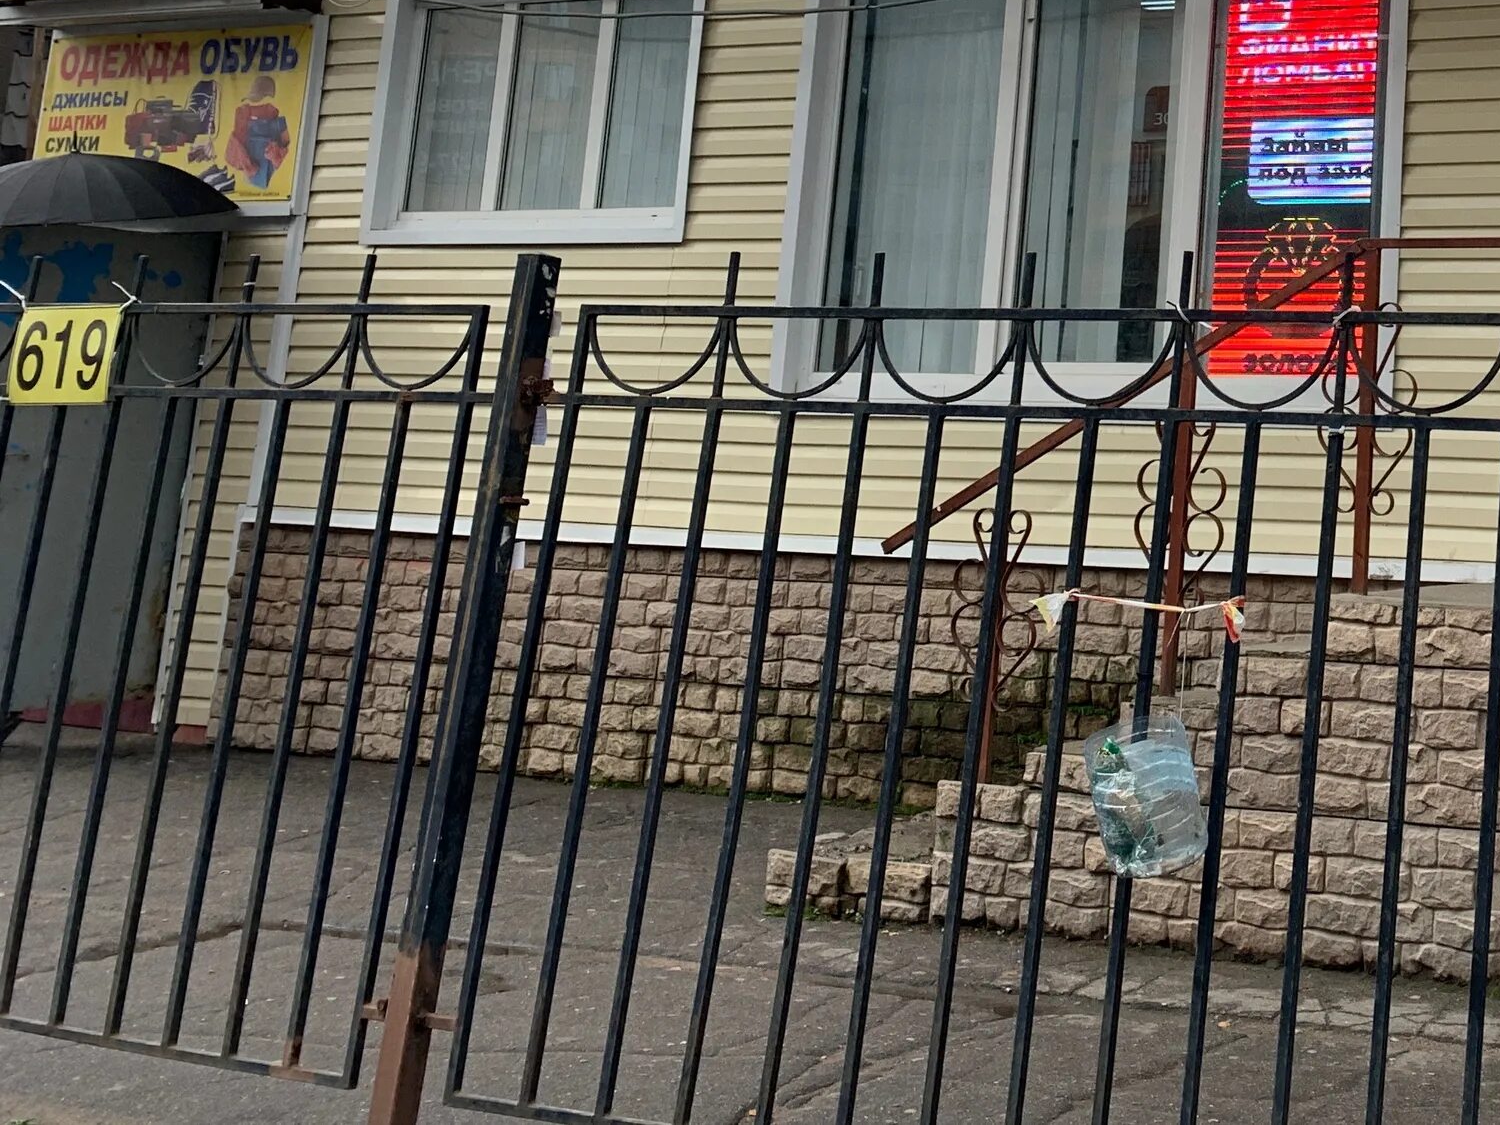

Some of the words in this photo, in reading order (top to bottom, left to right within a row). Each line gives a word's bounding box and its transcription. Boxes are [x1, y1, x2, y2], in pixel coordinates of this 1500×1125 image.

[60, 41, 190, 86] ОДЕЖДА
[200, 35, 298, 76] ОБУВЬ
[51, 90, 128, 112] ДЖИНСЫ
[48, 114, 107, 132] ШАПКИ
[45, 134, 100, 153] СУМКИ
[16, 319, 108, 391] 619
